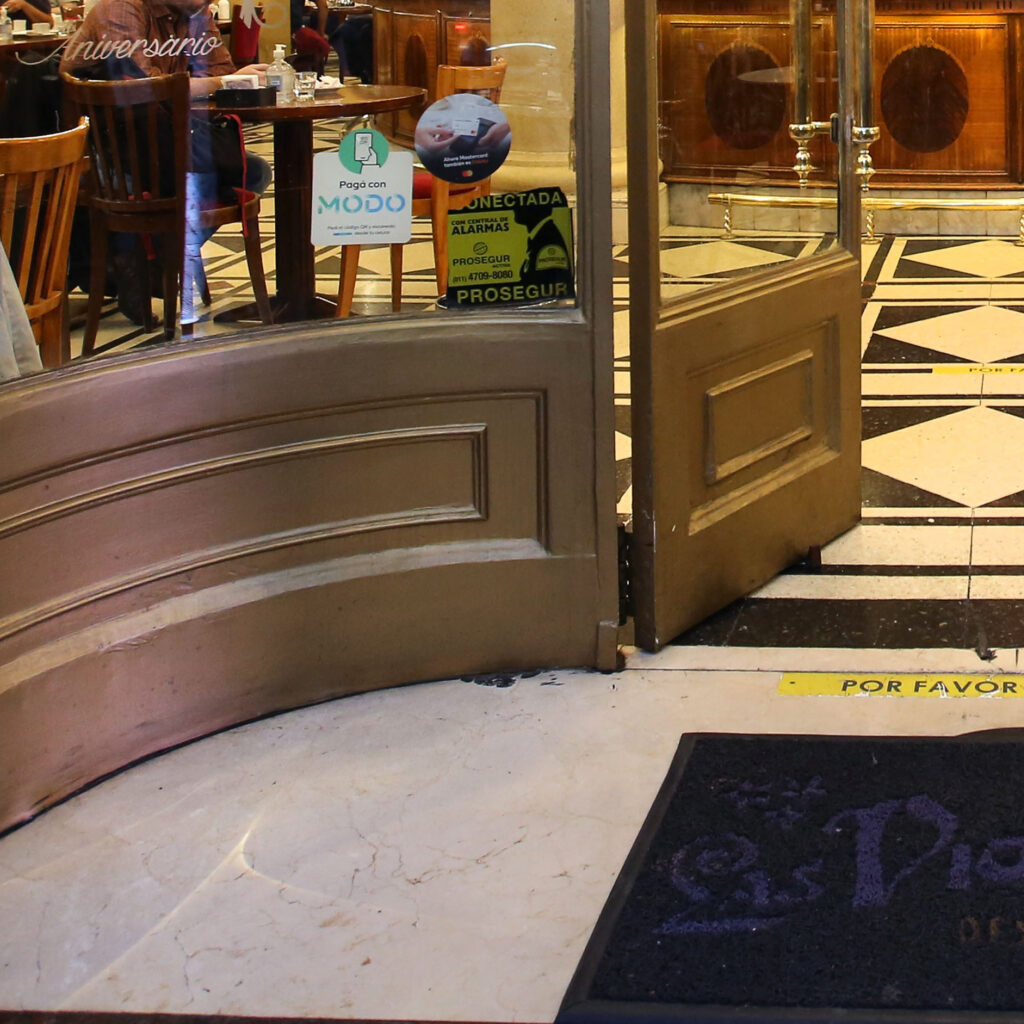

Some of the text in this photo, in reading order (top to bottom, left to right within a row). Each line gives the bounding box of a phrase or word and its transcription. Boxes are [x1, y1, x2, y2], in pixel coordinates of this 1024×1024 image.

[339, 180, 366, 190] Pagá
[317, 194, 406, 214] MODO
[460, 191, 562, 210] ONECTADA
[452, 223, 510, 235] ALARMAS
[452, 255, 510, 266] PROSEGUR
[457, 283, 567, 304] PROSEGUR
[842, 679, 902, 692] POR
[914, 679, 1017, 694] FAVOR
